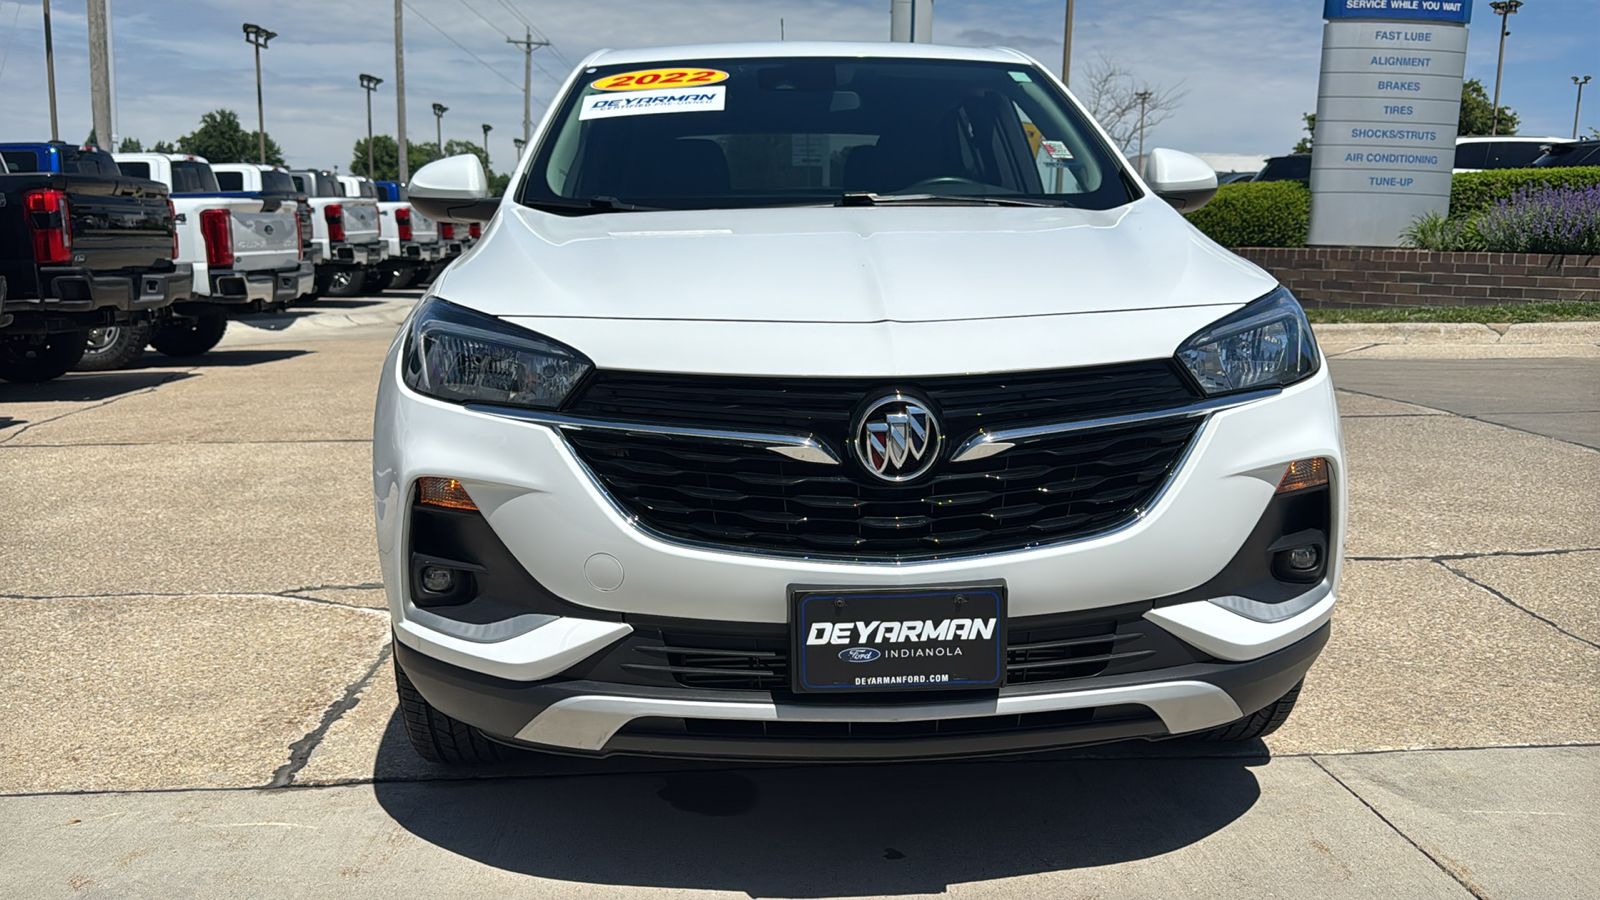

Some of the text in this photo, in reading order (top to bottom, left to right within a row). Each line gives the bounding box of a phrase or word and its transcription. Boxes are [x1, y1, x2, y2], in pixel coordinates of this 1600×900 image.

[1346, 0, 1462, 12] SERVICE WHILE YOU WAIT
[1375, 31, 1432, 42] FAST LUBE
[1370, 56, 1431, 67] ALIGNMENT
[605, 71, 716, 88] 2022
[1377, 81, 1421, 92] BRAKES
[592, 93, 717, 109] DEYARMAN
[1384, 105, 1413, 115] TIRES
[1351, 128, 1437, 141] SHOCKS/STRUTS
[1345, 153, 1438, 165] AIR CONDITIONING
[1369, 176, 1413, 187] TUNE-UP
[806, 617, 997, 646] DEYARMAN
[885, 647, 963, 658] INDIANOLA
[855, 674, 949, 686] DEYARMANFORD.COM
